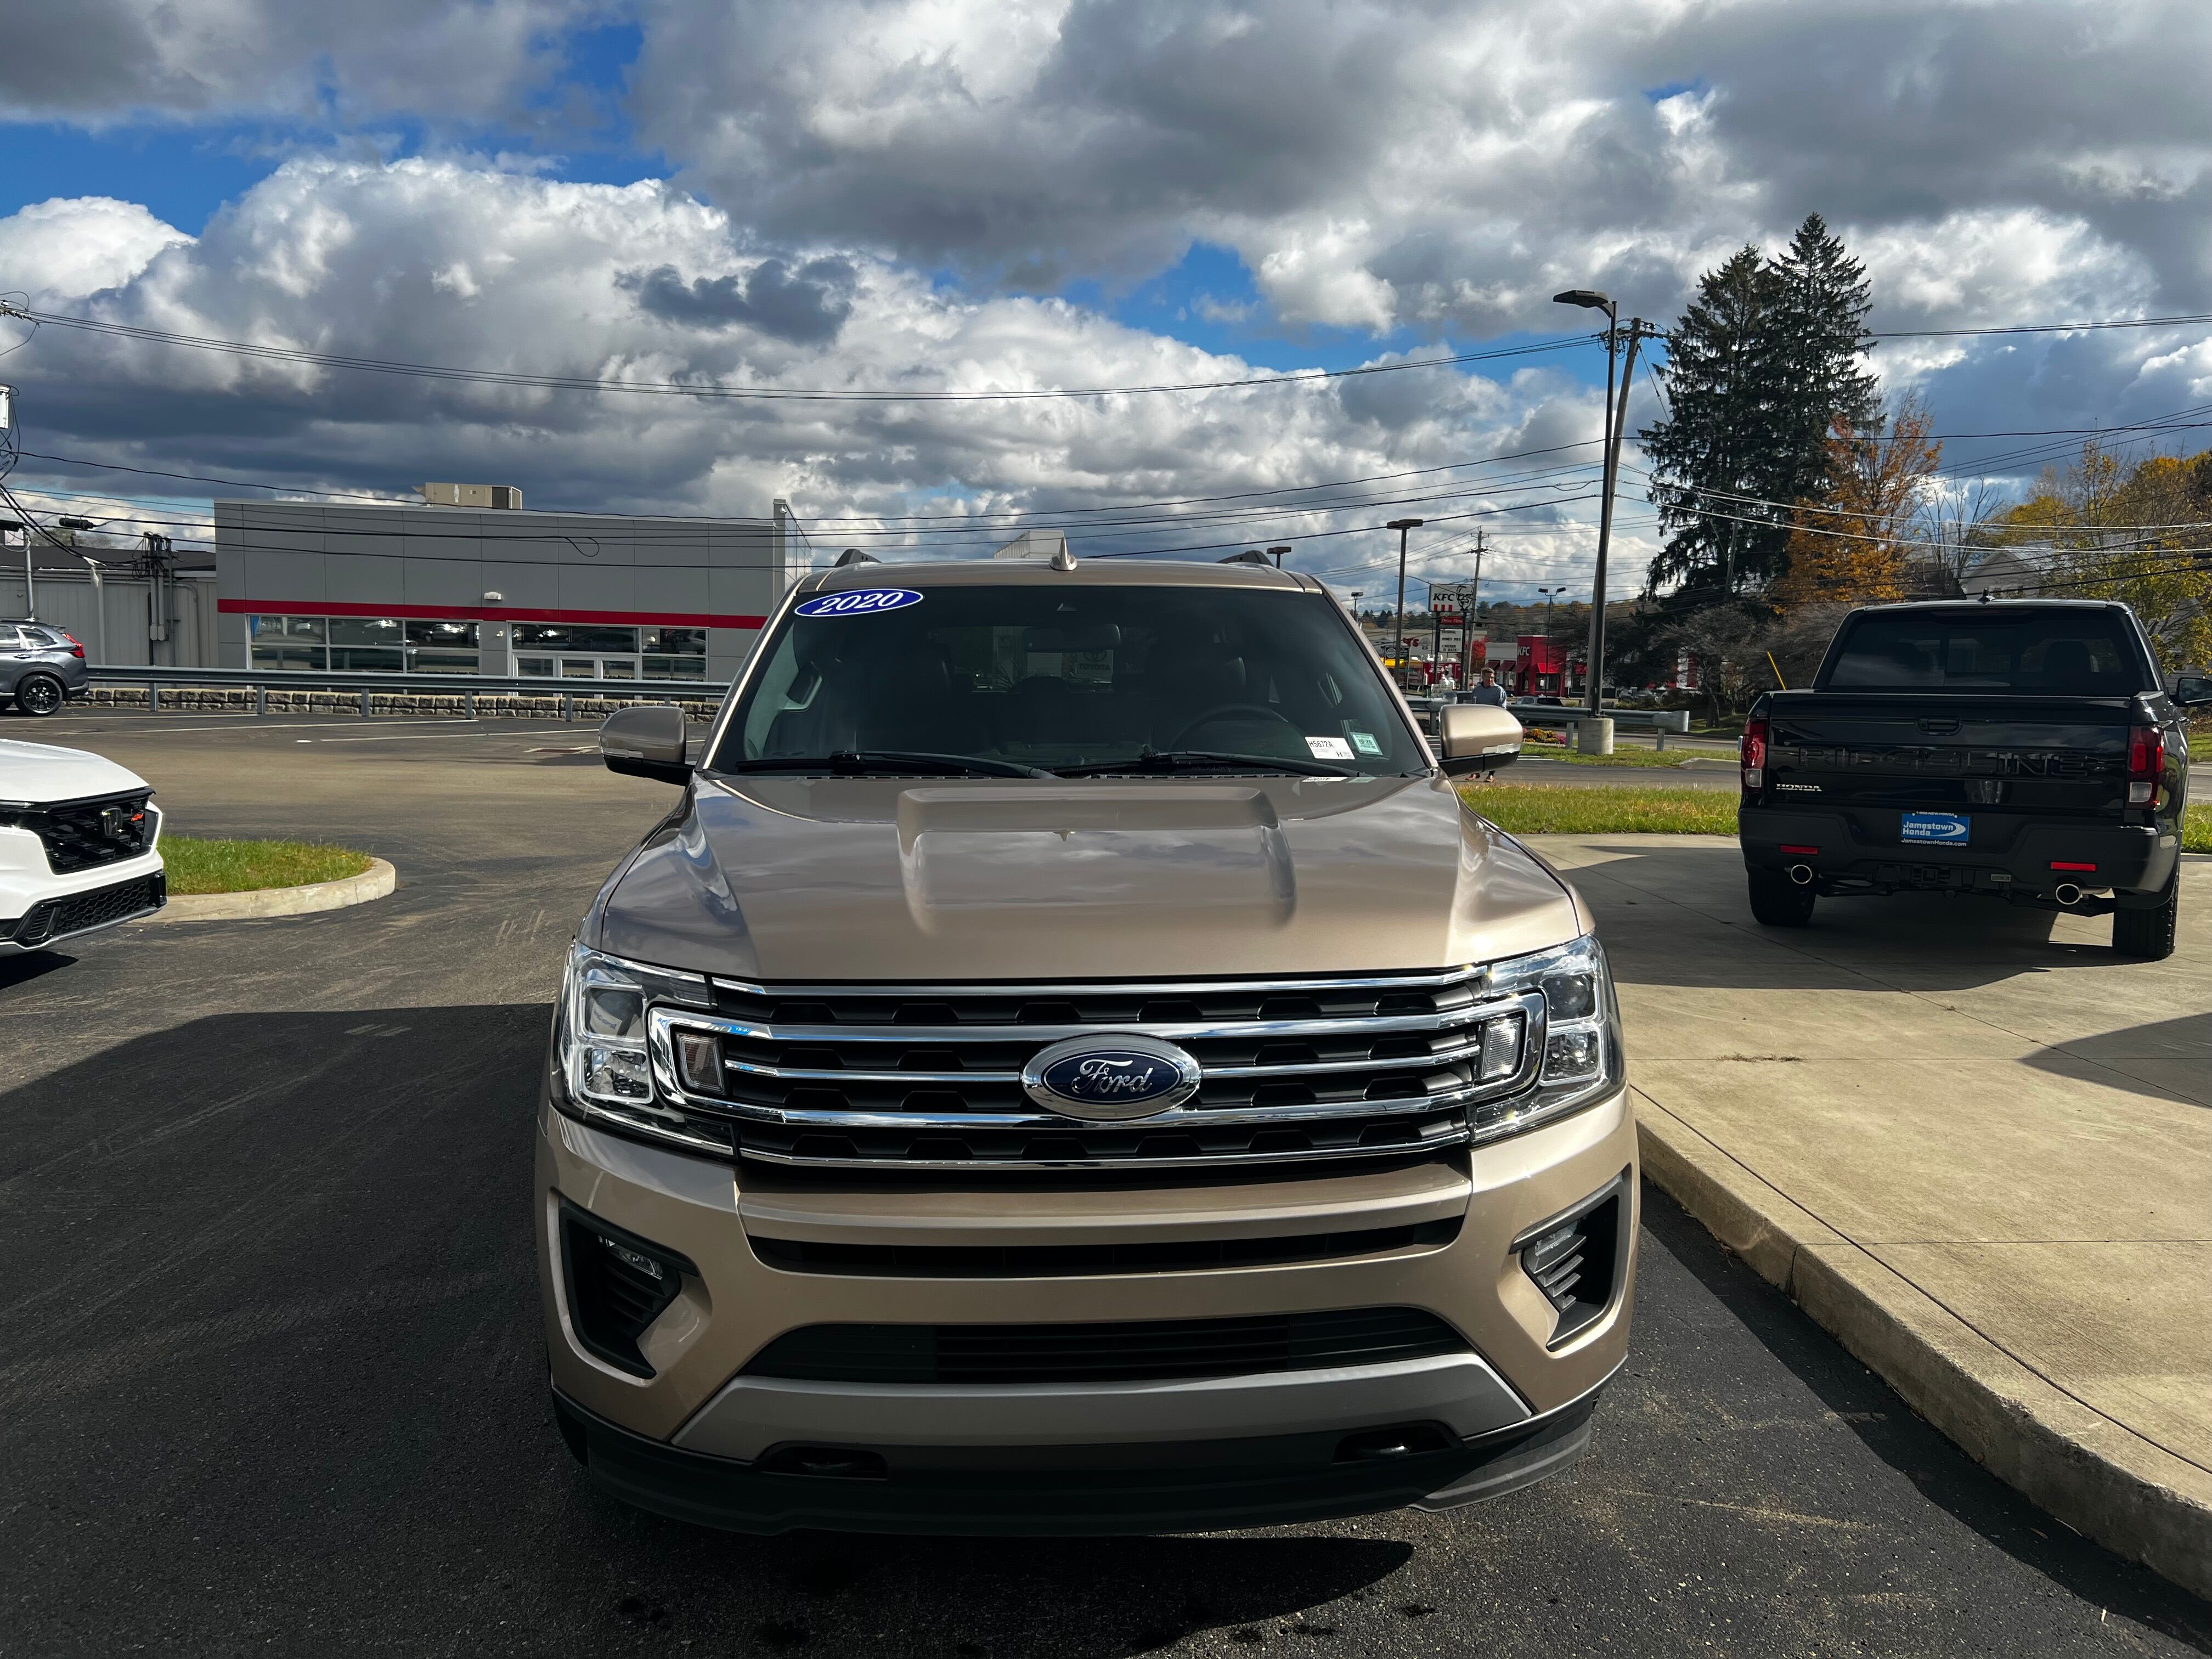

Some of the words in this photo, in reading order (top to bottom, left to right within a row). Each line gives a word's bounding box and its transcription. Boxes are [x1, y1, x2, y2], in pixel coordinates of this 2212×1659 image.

[1433, 593, 1454, 601] KFC
[812, 592, 904, 614] 2020
[1517, 646, 1531, 656] KFC
[1776, 783, 1822, 792] HONDA
[1903, 821, 1954, 831] Jamestown
[1903, 827, 1931, 836] Honda
[1901, 838, 1967, 847] JamestownHonda.com
[1071, 1059, 1154, 1093] Ford
